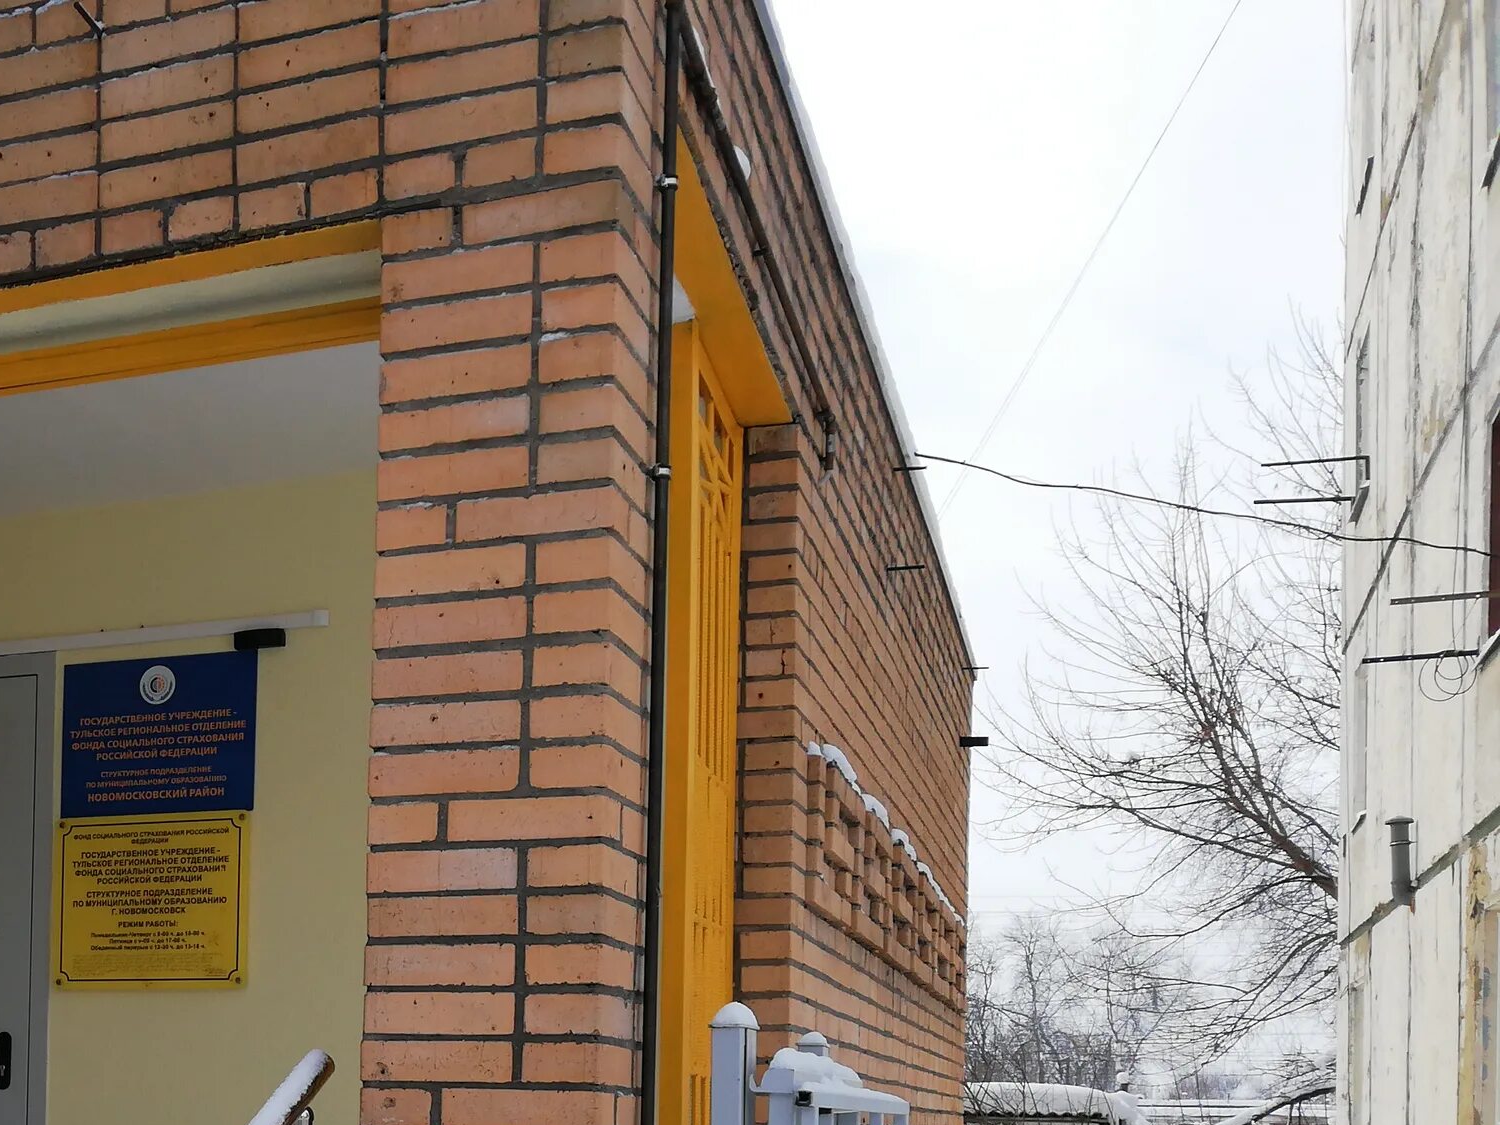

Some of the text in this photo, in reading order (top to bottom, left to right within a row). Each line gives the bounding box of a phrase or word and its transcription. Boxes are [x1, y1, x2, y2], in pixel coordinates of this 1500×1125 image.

[80, 713, 167, 727] ГОСУДАРСТВЕННОЕ
[168, 709, 232, 722] УЧРЕЖДЕНИЕ
[70, 720, 247, 739] ТУЛЬСКОЕ РЕГИОНАЛЬНОЕ ОТДЕЛЕНИЕ
[72, 732, 244, 751] ФОНДА СОЦИАЛЬНОГО СТРАХОВАНИЯ
[96, 747, 218, 761] РОССИЙСКОЙ ФЕДЕРАЦИИ
[101, 766, 213, 778] СТРУКТУРНОЕ ПОДРАЗДЕЛЕНИЕ
[98, 778, 170, 788] МУНИЦИПАЛЬНОМУ
[171, 775, 227, 785] ОБРАЗОВАНИЮ
[88, 786, 225, 802] НОВОМОСКОВСКИЙ РАЙОН
[92, 831, 139, 840] СОЦИАЛЬНОГО
[140, 829, 185, 838] СТРАХОВАНИЯ
[186, 826, 229, 835] РОССИЙСКОЙ
[131, 837, 169, 845] ФЕДЕРАЦИИ
[81, 849, 159, 859] ГОСУДАРСТВЕННОЕ
[160, 847, 215, 856] УЧРЕЖДЕНИЕ
[73, 856, 229, 869] ТУЛЬСКОЕ РЕГИОНАЛЬНОЕ ОТДЕЛЕНИЕ
[75, 865, 226, 877] ФОНДА СОЦИАЛЬНОГО СТРАХОВАНИЯ
[97, 875, 203, 885] РОССИЙСКОЙ ФЕДЕРАЦИИ
[86, 888, 213, 898] СТРУКТУРНОЕ ПОДРАЗДЕЛЕНИЕ
[73, 897, 227, 908] ПО МУНИЦИПАЛЬНОМУ ОБРАЗОВАНИЮ
[119, 907, 186, 915] НОВОМОСКОВСК
[145, 920, 178, 928] РАБОТЫ:
